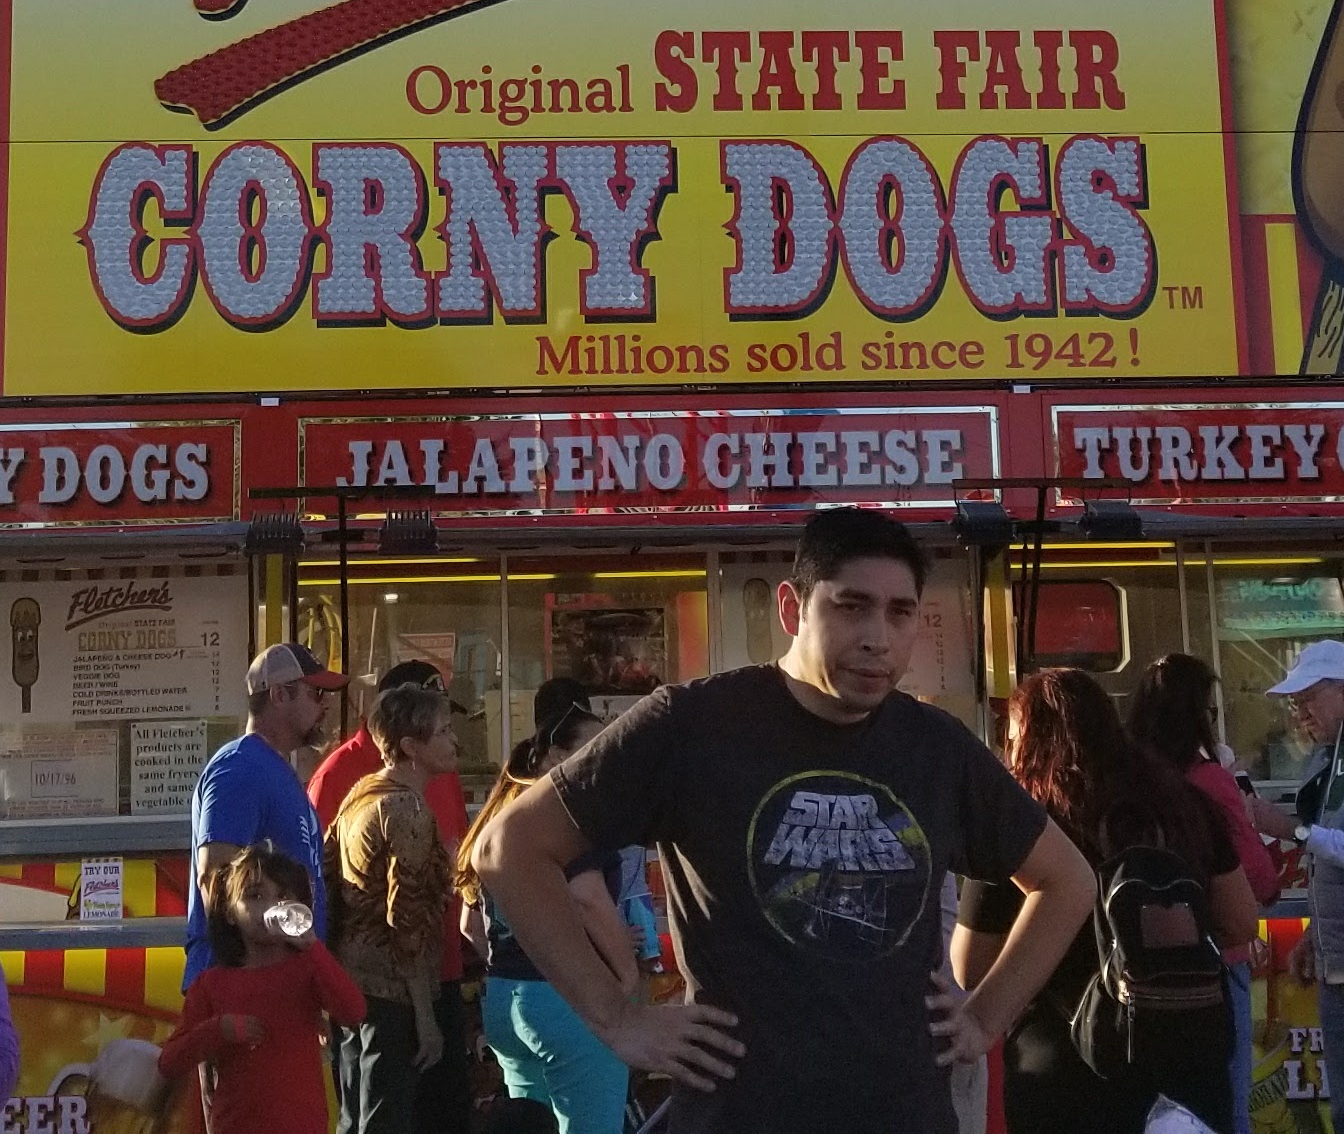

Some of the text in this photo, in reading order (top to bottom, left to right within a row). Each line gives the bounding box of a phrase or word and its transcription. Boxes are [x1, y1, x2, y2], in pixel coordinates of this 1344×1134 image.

[406, 30, 1125, 125] Original STATE FAIR
[73, 134, 1203, 334] CORNY DOGS TM
[537, 333, 729, 375] Millions
[748, 332, 843, 372] sold
[862, 330, 984, 371] since
[336, 430, 963, 494] JALAPENO CHEESE
[1074, 424, 1325, 482] TURKEY
[38, 443, 209, 504] DOGS
[67, 580, 172, 621] Fletcher's
[925, 614, 941, 627] 12
[78, 628, 220, 651] CORNY DOGS 12
[136, 726, 204, 739] All Fletcher's
[135, 755, 203, 766] cooked in the
[136, 742, 202, 755] products are
[139, 769, 200, 780] same fryers
[144, 783, 194, 793] and same
[136, 796, 184, 809] vegetable
[782, 791, 888, 829] STAR
[764, 823, 916, 871] WARS
[84, 866, 120, 875] TRY OUR
